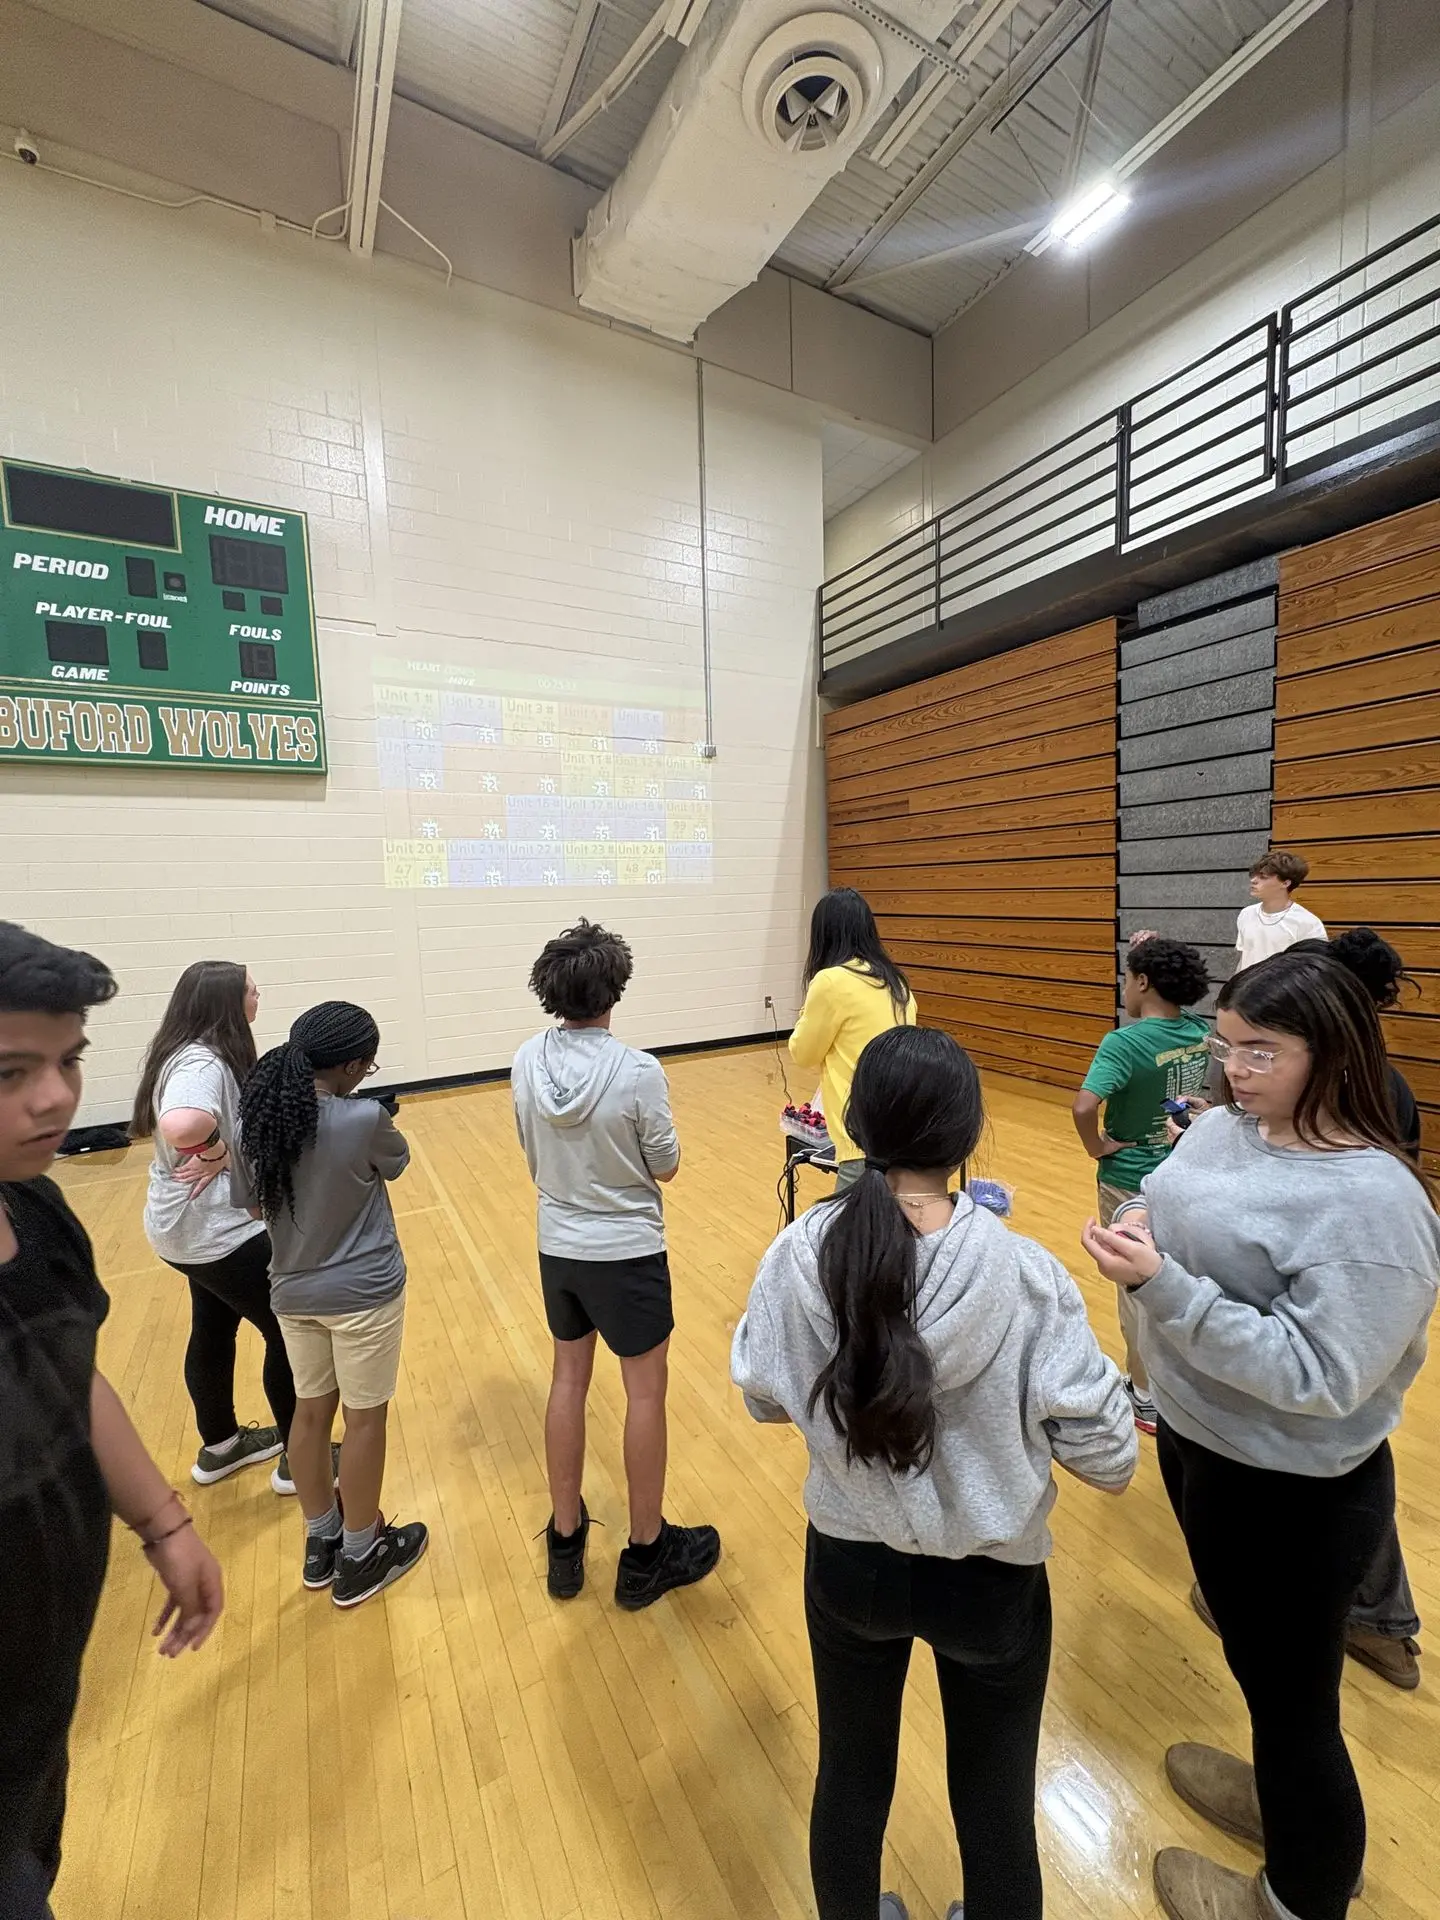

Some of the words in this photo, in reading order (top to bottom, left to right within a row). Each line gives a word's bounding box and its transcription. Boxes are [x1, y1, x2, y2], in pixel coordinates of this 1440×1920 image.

[204, 506, 286, 536] HOME
[13, 552, 109, 580] PERIOD
[35, 601, 172, 628] PLAYER-FOUL
[229, 624, 282, 641] FOULS
[51, 665, 109, 681] GAME
[406, 660, 441, 672] HEART
[230, 680, 290, 696] POINTS
[380, 688, 408, 703] Unit
[507, 698, 532, 714] Unit
[0, 696, 152, 754] BUFORD
[158, 707, 318, 762] WOLVES
[563, 753, 586, 765] Unit
[386, 843, 414, 854] Unit
[450, 844, 475, 855] Unit
[510, 844, 533, 855] Unit
[566, 844, 588, 855] Unit
[618, 844, 640, 855] Unit
